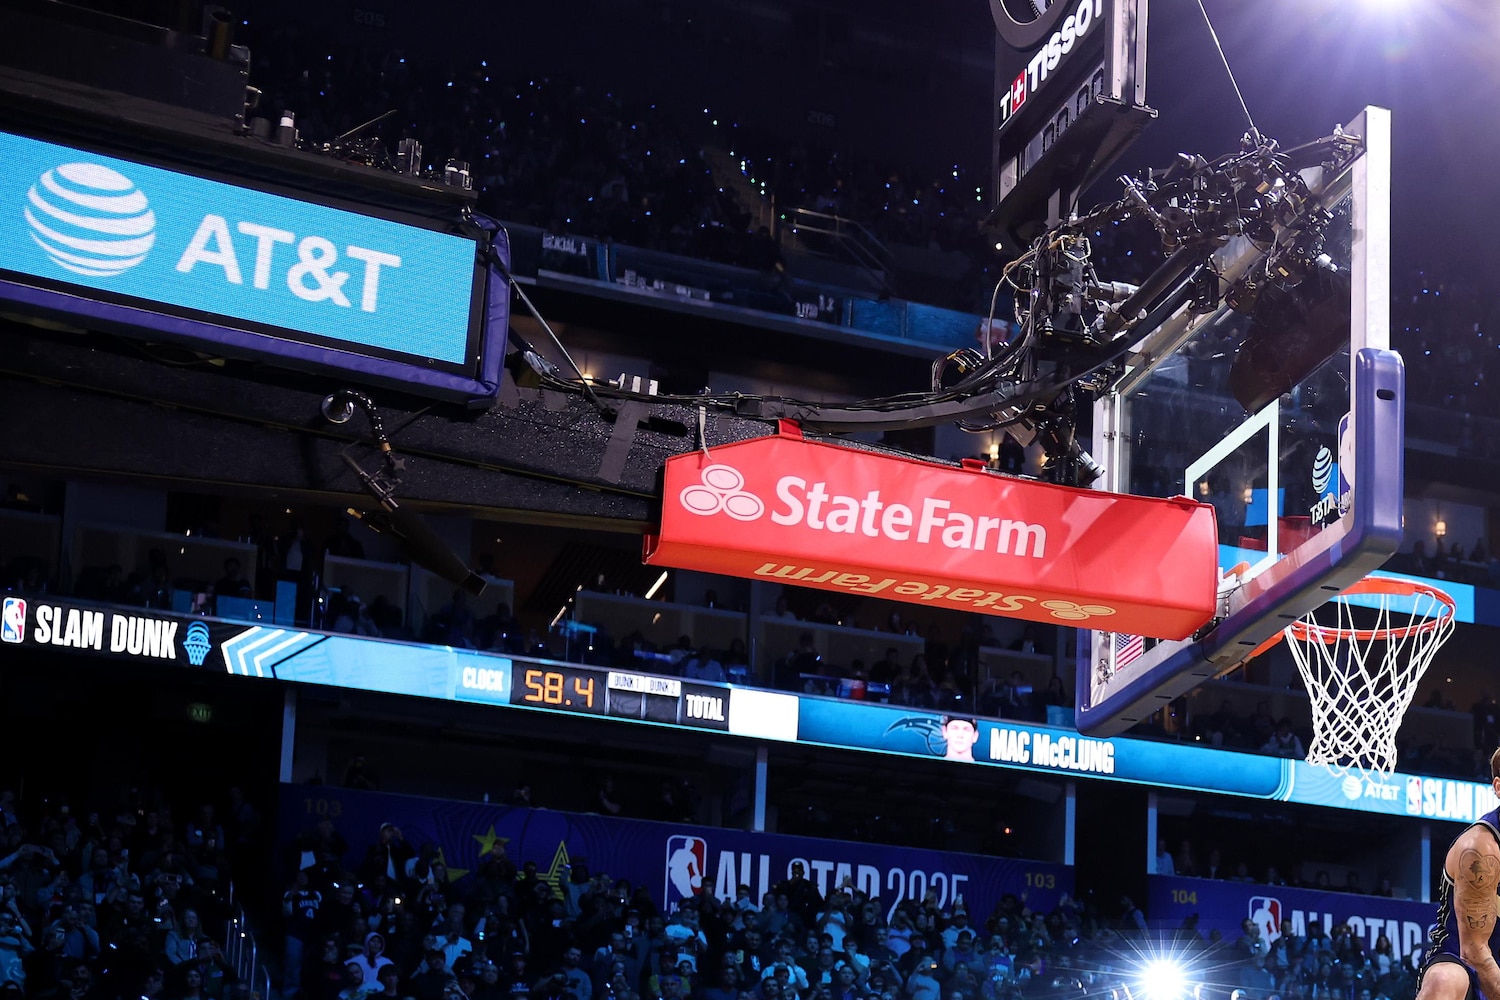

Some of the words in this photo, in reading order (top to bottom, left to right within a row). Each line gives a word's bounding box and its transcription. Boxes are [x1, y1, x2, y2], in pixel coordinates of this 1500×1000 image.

[176, 214, 401, 313] AT&T
[34, 604, 104, 651] SLAM
[110, 614, 178, 660] DUNK
[462, 666, 504, 692] CLOCK
[524, 670, 594, 708] 58.4
[686, 694, 725, 722] TOTAL
[990, 728, 1030, 764] MAC
[1032, 733, 1115, 774] McCLUNG
[1364, 784, 1400, 800] AT&T
[1423, 779, 1473, 820] SLAM
[787, 857, 881, 903] TAR
[1024, 872, 1056, 889] 103
[1171, 889, 1198, 905] 104
